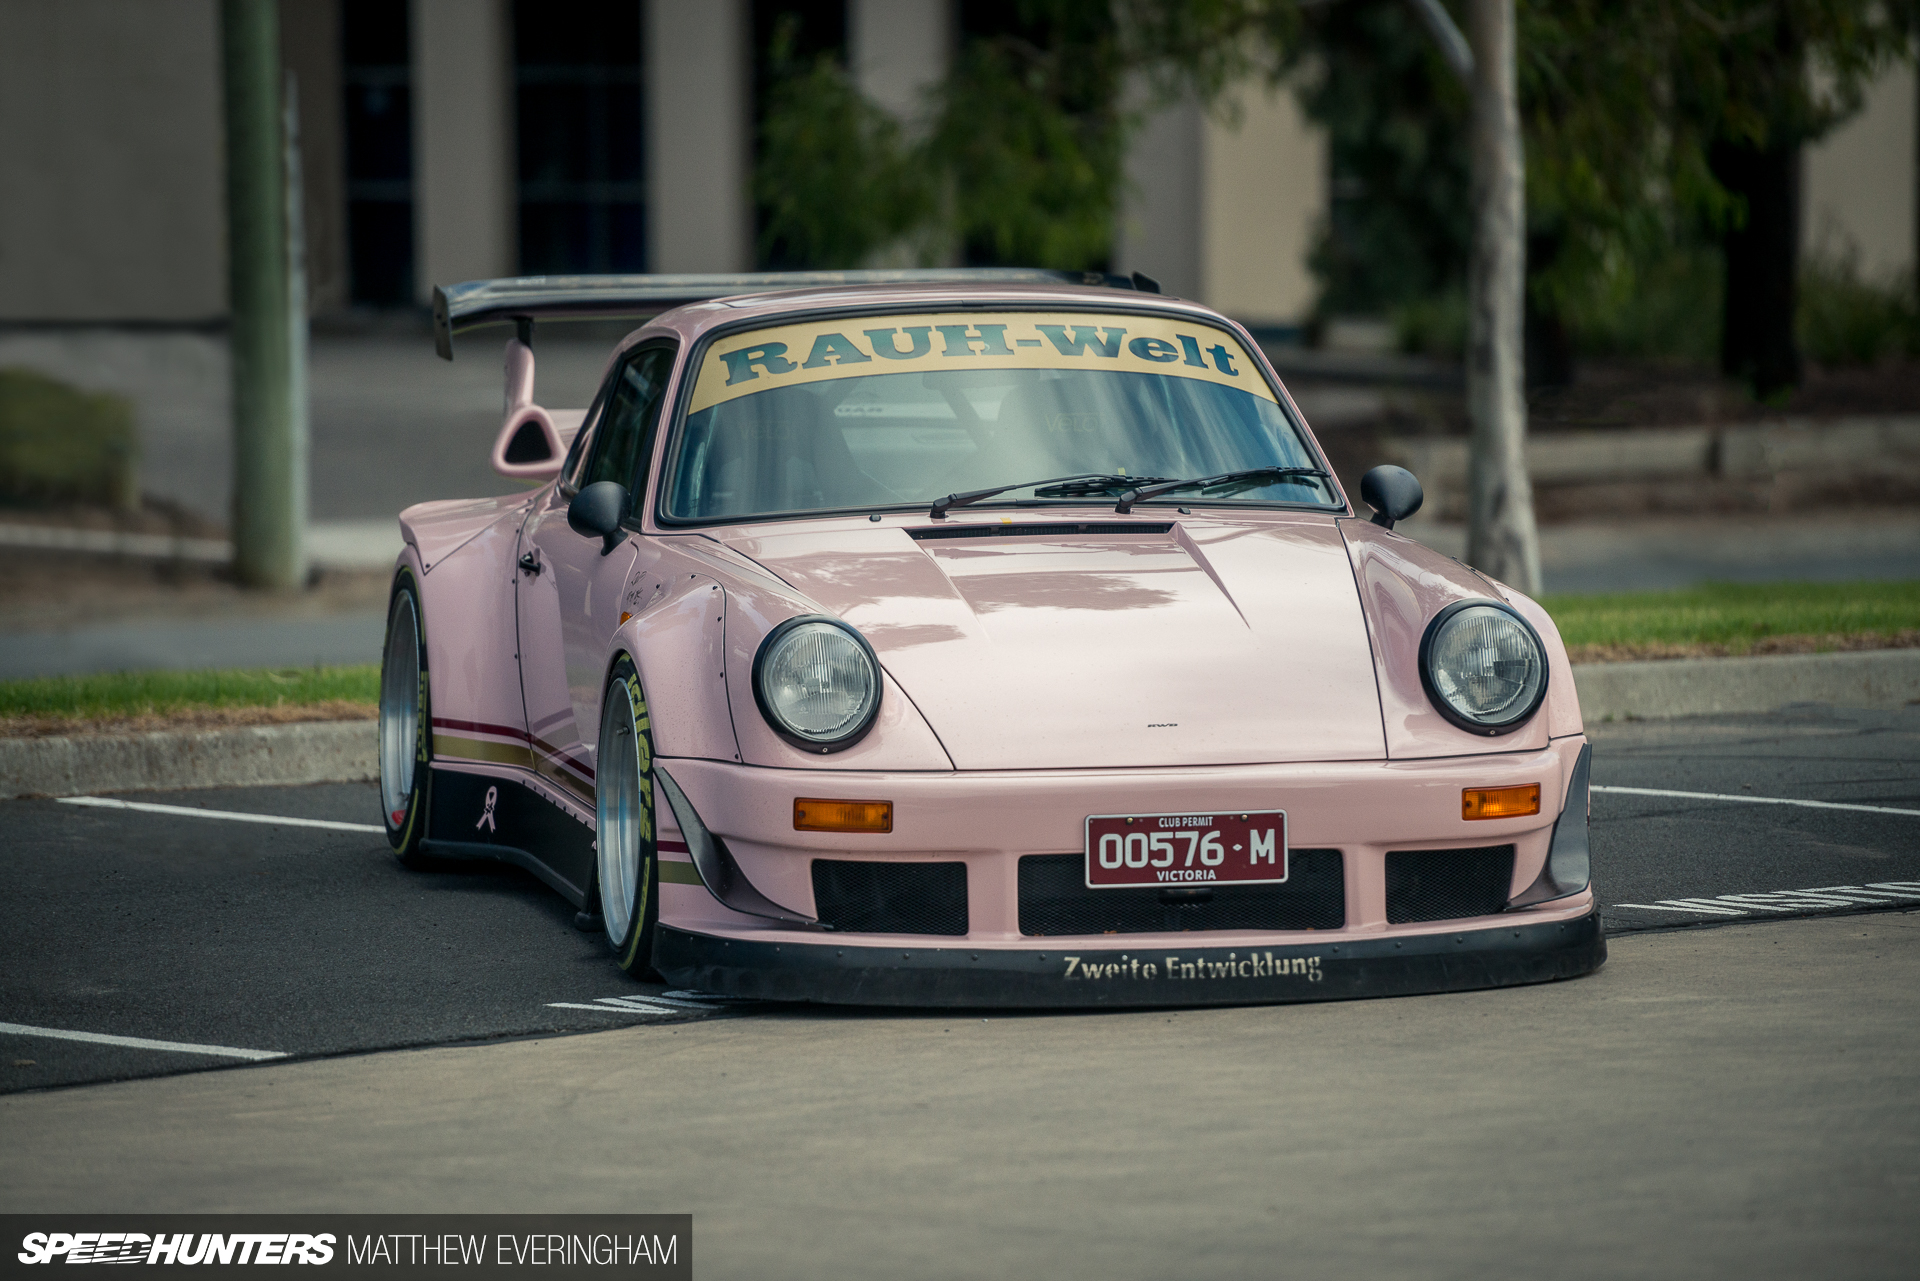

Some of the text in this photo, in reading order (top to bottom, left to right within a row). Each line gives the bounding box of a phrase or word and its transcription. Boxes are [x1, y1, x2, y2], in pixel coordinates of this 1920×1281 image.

[718, 322, 1240, 387] RAUH-Welt
[1158, 816, 1214, 828] CLUB PERMIT
[1156, 869, 1217, 882] VICTORIA
[1063, 952, 1323, 982] Zweite Entwicklung
